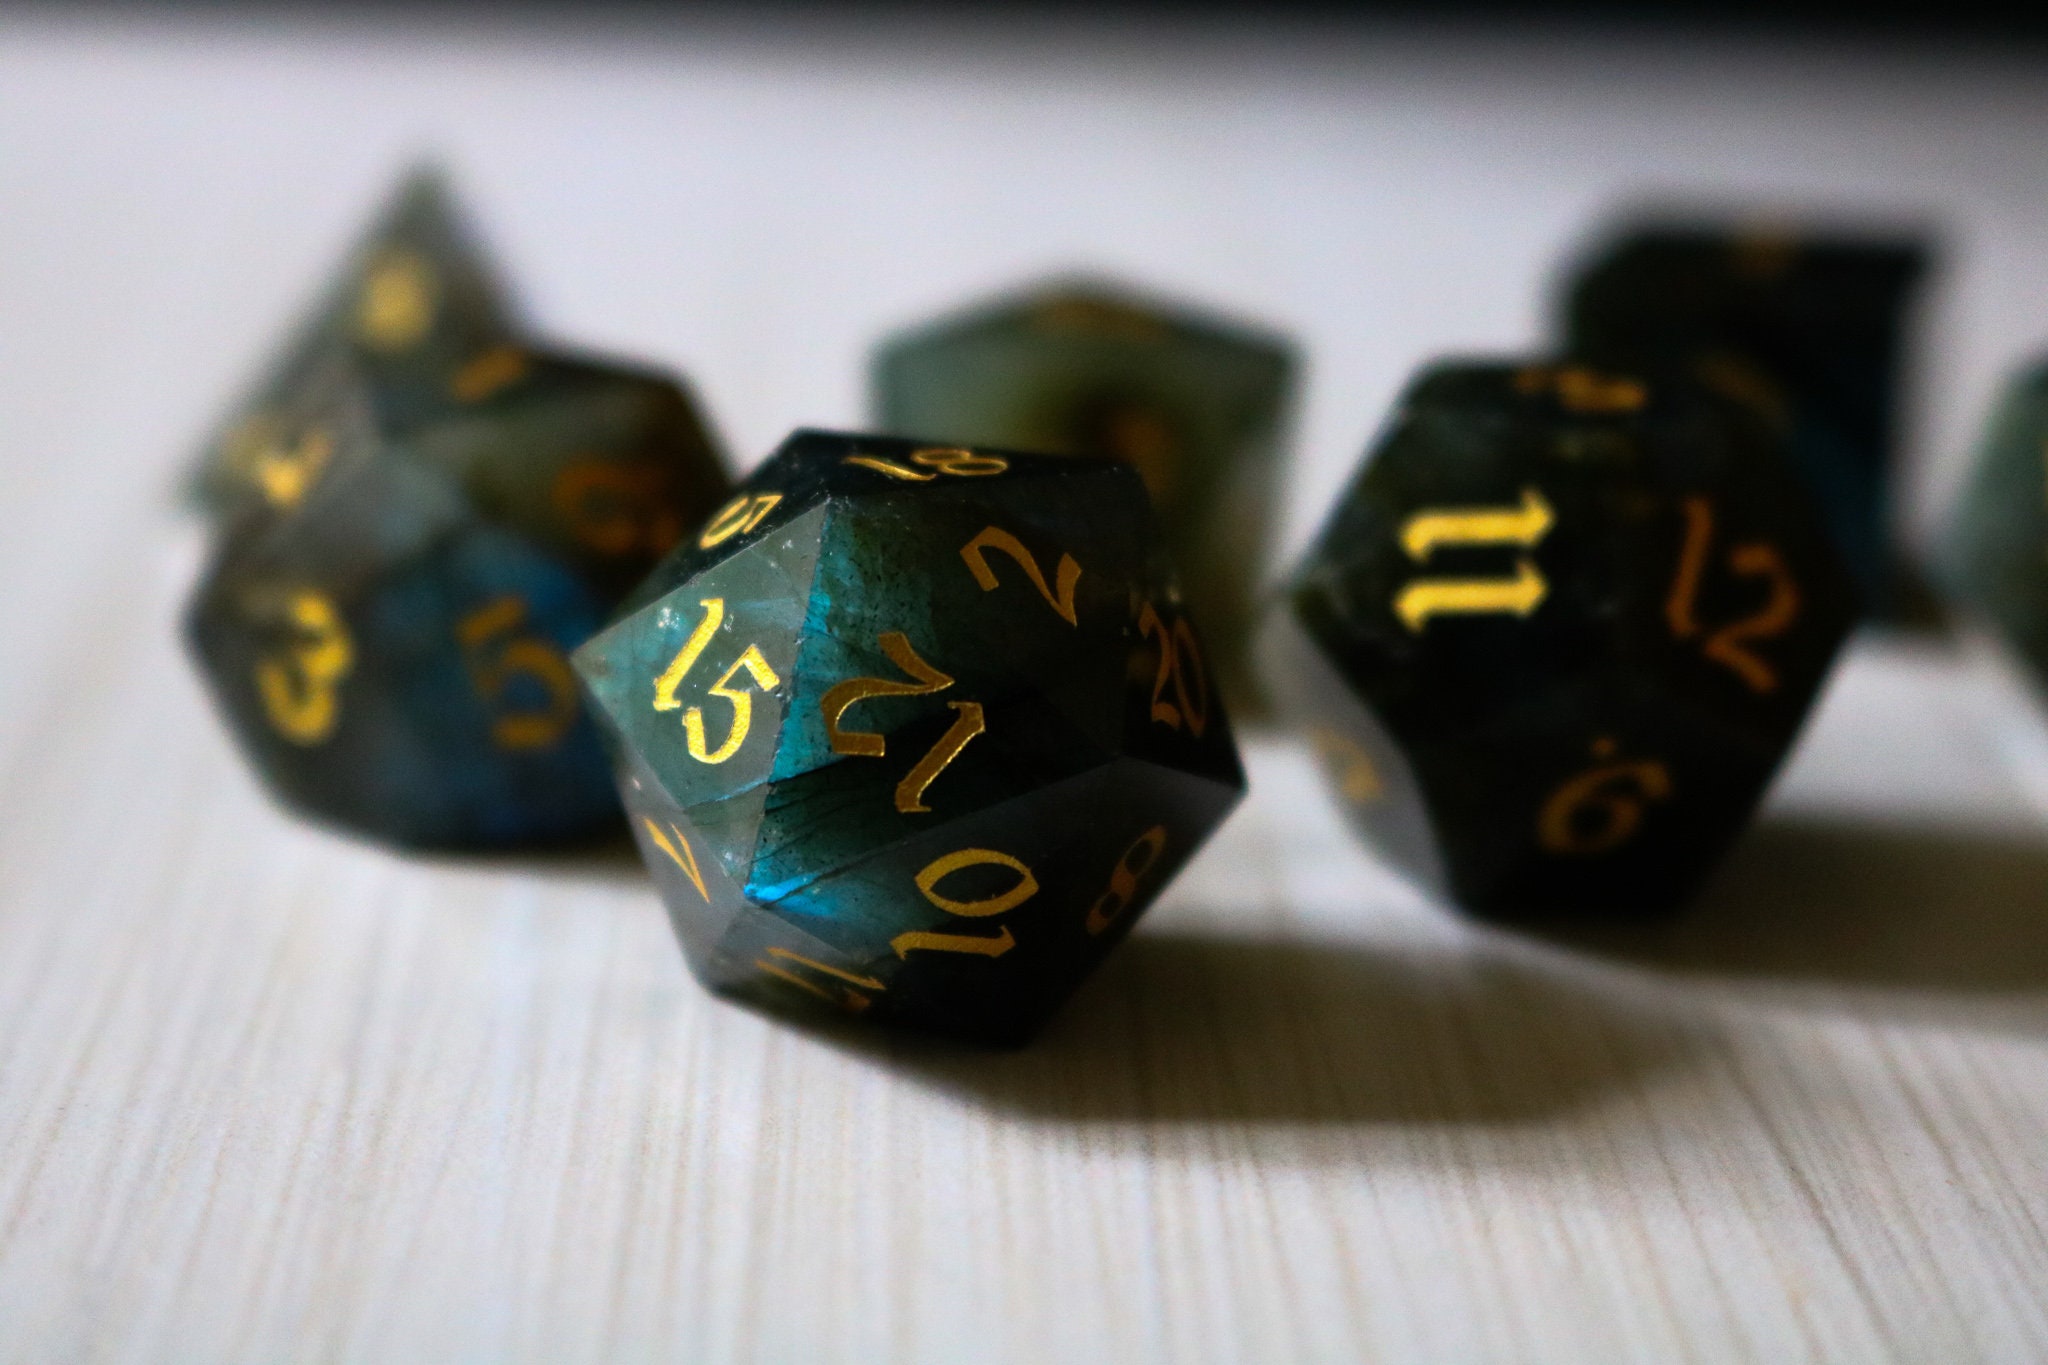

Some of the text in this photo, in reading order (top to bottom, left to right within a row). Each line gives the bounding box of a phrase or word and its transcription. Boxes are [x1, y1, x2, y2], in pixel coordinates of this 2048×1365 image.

[841, 449, 1009, 482] 18
[960, 526, 1082, 628] 2
[1395, 488, 1557, 633] 11
[1667, 498, 1798, 693] 12
[256, 590, 353, 746] 3
[652, 598, 780, 764] 15
[1138, 601, 1208, 738] 20
[889, 848, 1040, 960] 10
[1086, 825, 1168, 936] 8
